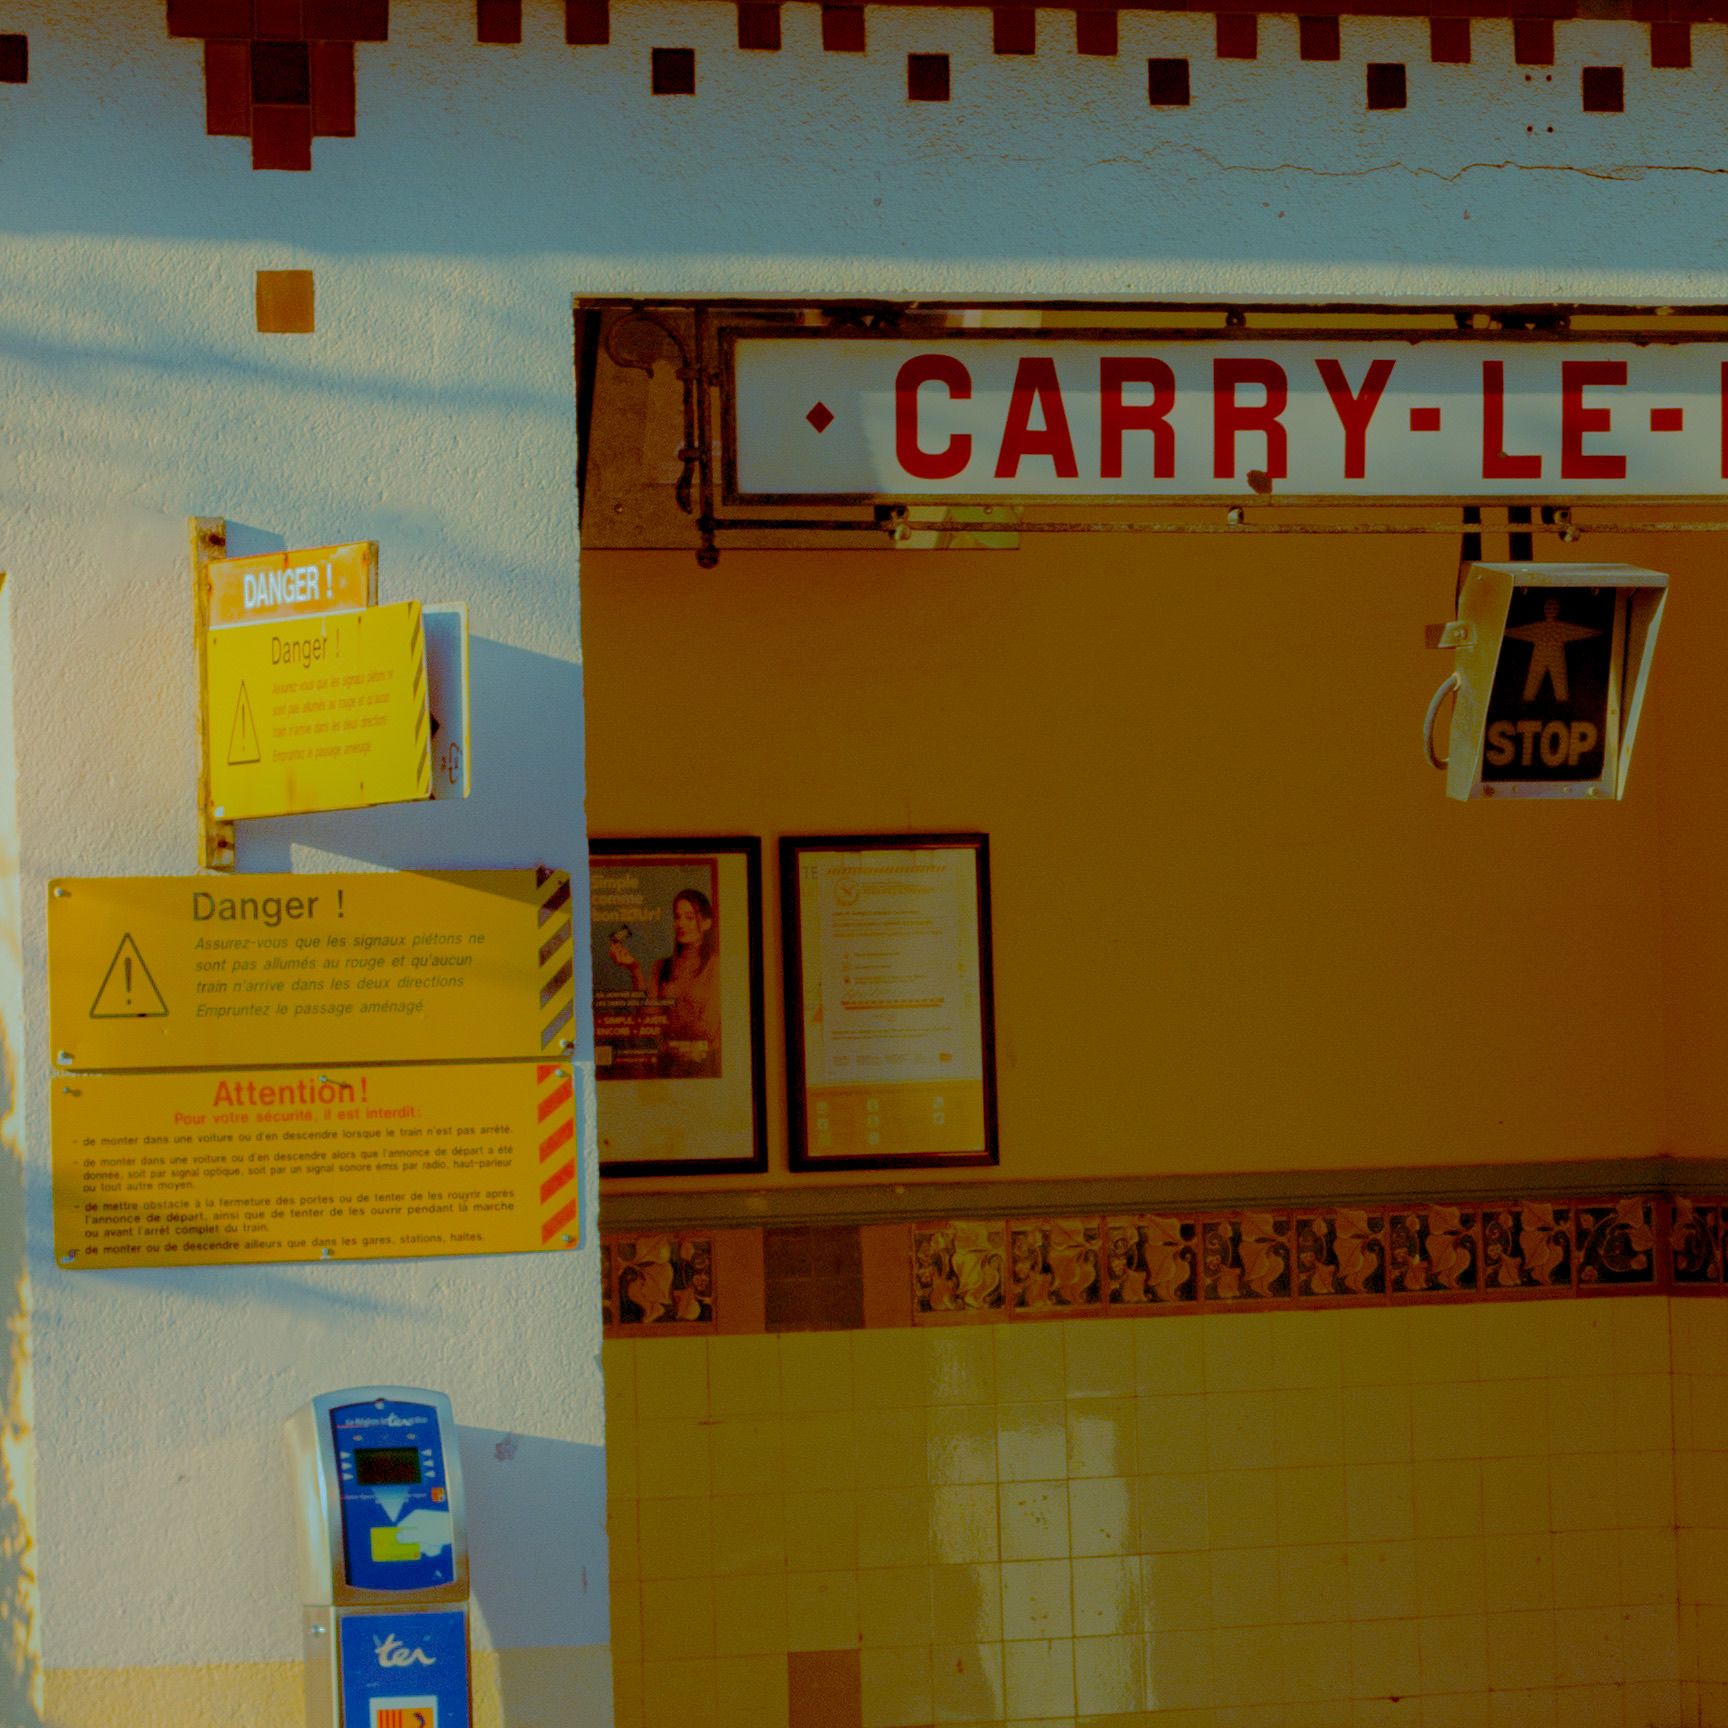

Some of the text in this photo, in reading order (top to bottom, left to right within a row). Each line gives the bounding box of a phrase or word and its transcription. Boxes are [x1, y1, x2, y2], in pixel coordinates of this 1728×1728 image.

[244, 563, 333, 609] DANGER !
[271, 627, 341, 669] Danger !
[1485, 719, 1599, 767] STOP
[192, 889, 345, 927] Danger !
[194, 932, 484, 950] Assurez-vous que les signaux piétons ne
[196, 954, 472, 973] sont pas allumés au rouge et qu'aucun
[196, 974, 463, 992] train n'arrive dans les deux directions
[195, 999, 423, 1018] Empruntez le passage aménagé
[174, 1111, 206, 1125] Pour
[212, 1110, 248, 1124] votre
[323, 1108, 331, 1121] il
[336, 1107, 359, 1120] est
[82, 1135, 95, 1145] de
[101, 1134, 138, 1145] monter
[143, 1133, 168, 1144] dans
[198, 1132, 233, 1142] voiture
[255, 1130, 277, 1141] d'en
[282, 1129, 337, 1140] descendre
[342, 1128, 381, 1138] lorsque
[385, 1128, 394, 1138] le
[399, 1127, 422, 1137] train
[426, 1127, 452, 1137] n'est
[456, 1128, 475, 1136] pas
[374, 1633, 436, 1668] ter
